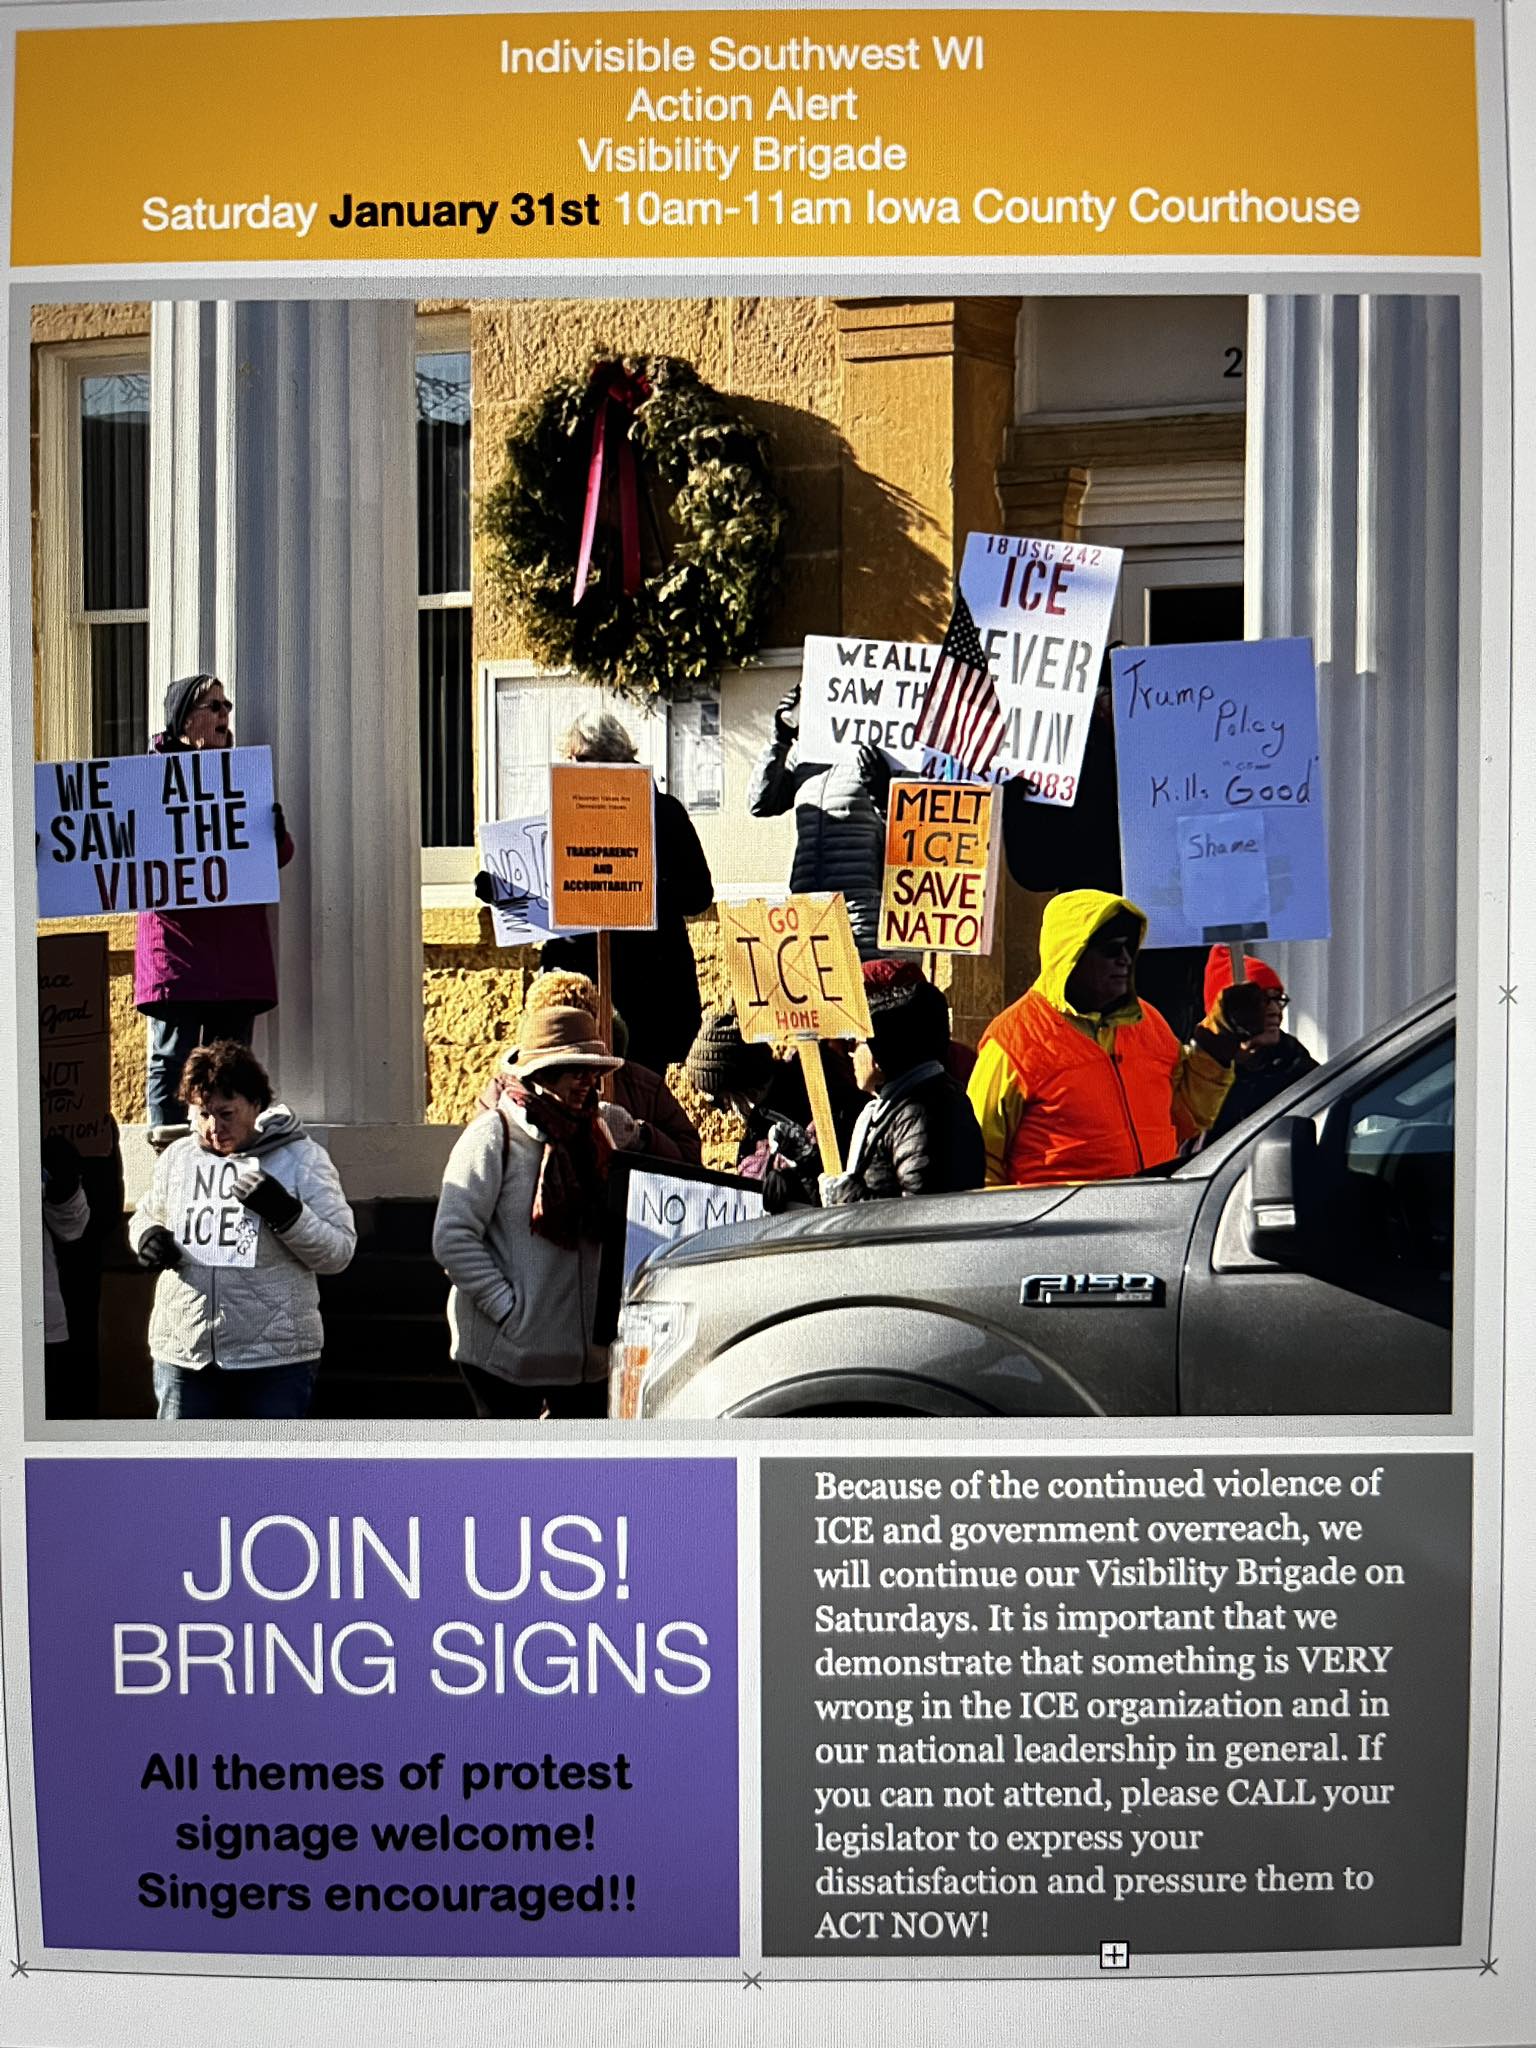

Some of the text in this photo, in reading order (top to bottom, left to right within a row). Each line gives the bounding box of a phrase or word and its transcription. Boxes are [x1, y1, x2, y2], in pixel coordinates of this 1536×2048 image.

[502, 37, 983, 73] Indivisible Southwest WI
[627, 86, 857, 121] Action Alert
[578, 137, 906, 180] Visibility Brigade
[143, 188, 1359, 237] Saturday January 31st 10am-11am Iowa County Courthouse
[1223, 346, 1243, 378] 2
[986, 536, 1102, 566] 18 USC 242
[1000, 556, 1075, 615] ICE
[984, 629, 1093, 693] EVER
[827, 677, 930, 709] SAW TH
[1122, 659, 1215, 718] Trump
[831, 716, 917, 750] VIDEO
[996, 707, 1075, 765] AIN
[55, 752, 245, 812] WE ALL
[896, 788, 992, 825] MELT
[50, 801, 250, 863] SAW THE
[1187, 834, 1259, 860] Shame
[566, 846, 639, 858] TRANSPARENCY
[593, 864, 613, 875] AND
[94, 855, 229, 911] VIDEO
[563, 880, 643, 892] ACCOUNTABILITY
[893, 869, 981, 909] SAVE
[768, 907, 799, 934] GO
[736, 935, 843, 1007] ICE
[775, 1010, 820, 1030] HOME
[193, 1162, 239, 1200] NO
[641, 1189, 687, 1225] NO
[182, 1206, 241, 1246] ICE
[815, 1468, 1384, 1500] Because of the continued violence of
[815, 1512, 1362, 1551] ICE and government overreach, we
[184, 1515, 629, 1601] JOIN US!
[814, 1556, 1405, 1593] will continue our Visibility Brigade on
[816, 1601, 1337, 1639] Saturdays. It is important that we
[114, 1622, 710, 1695] BRING SIGNS
[815, 1645, 1393, 1681] demonstrate that something is VERY
[814, 1689, 1390, 1727] wrong in the ICE organization and in
[816, 1733, 1386, 1769] our national leadership in general. If
[141, 1753, 632, 1800] All themes of protest
[814, 1778, 1394, 1815] you can not attend, please CALL your
[176, 1814, 593, 1860] signage welcome!
[815, 1823, 1203, 1858] legislator to express your
[138, 1872, 634, 1921] Singers encouraged!!
[816, 1864, 1373, 1901] dissatisfaction and pressure them to
[814, 1911, 988, 1939] ACT NOW!
